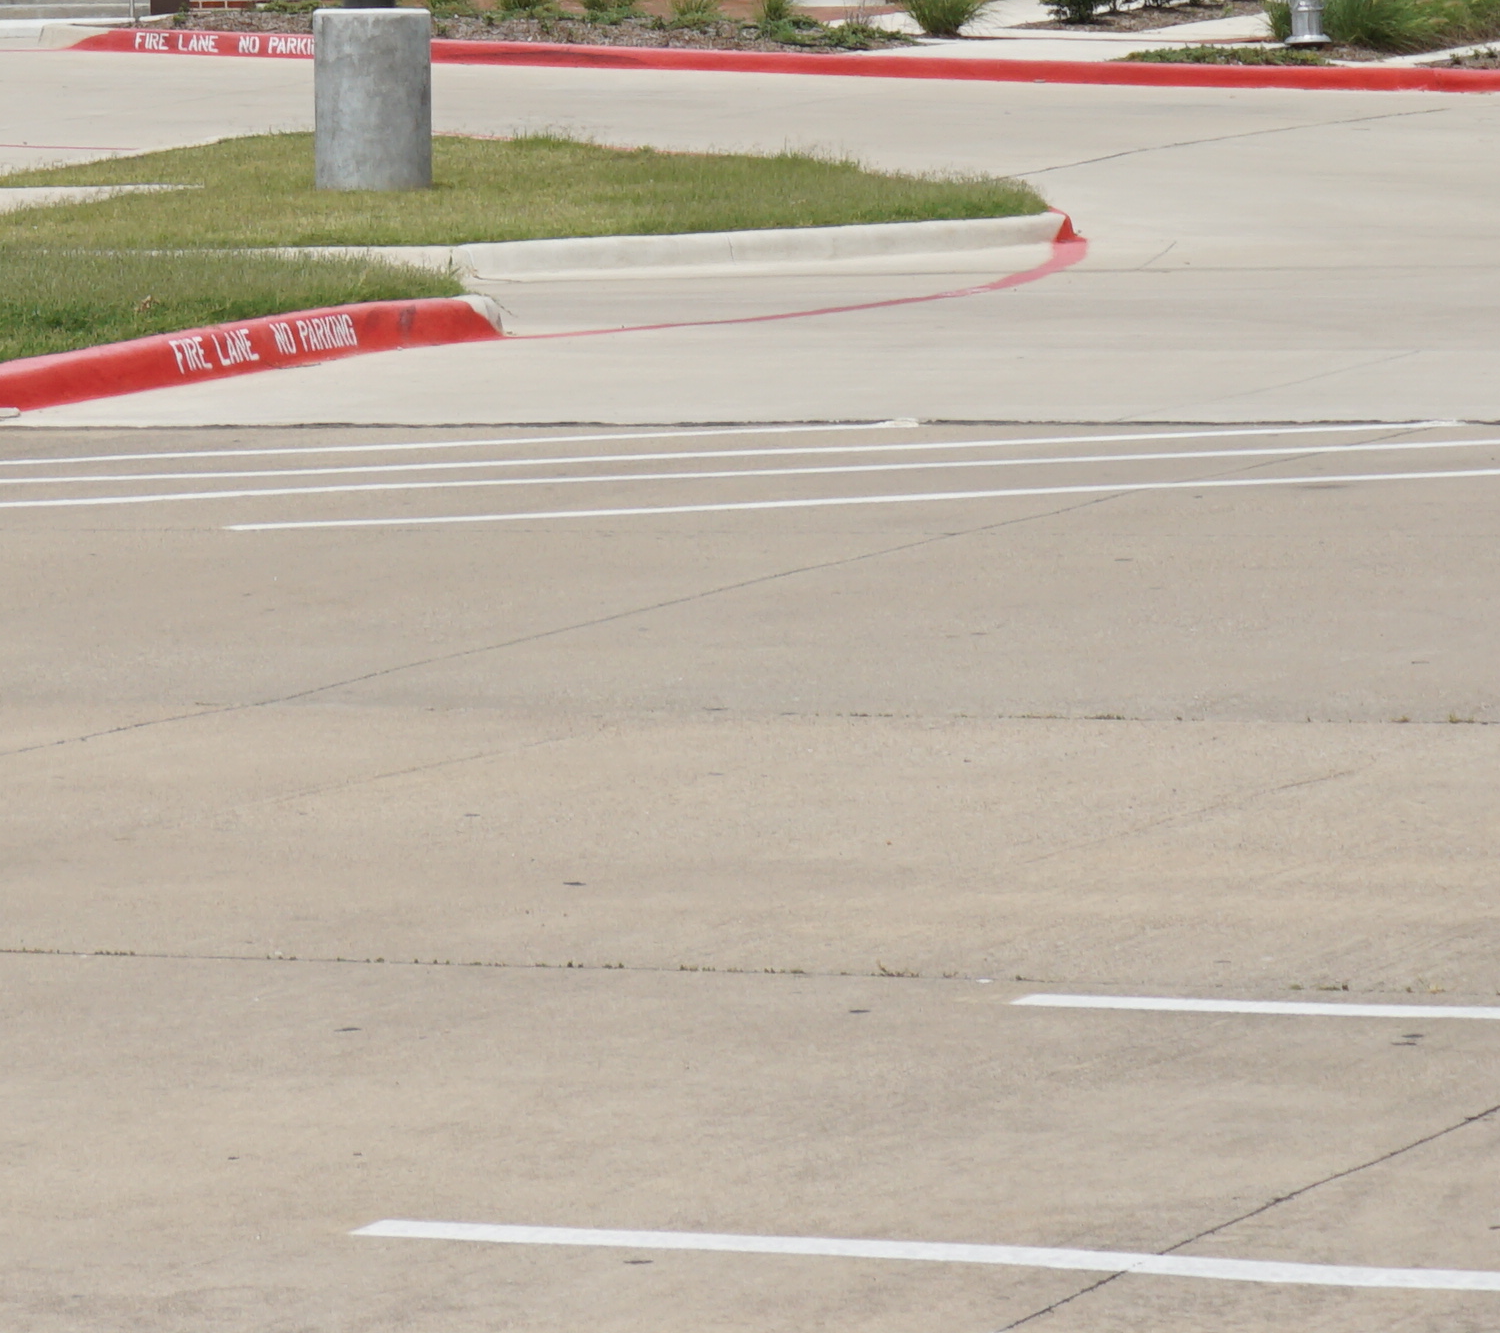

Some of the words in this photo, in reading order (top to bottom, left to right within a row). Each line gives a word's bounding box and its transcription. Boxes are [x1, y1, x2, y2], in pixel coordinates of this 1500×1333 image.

[134, 32, 170, 51] FIRE
[177, 33, 219, 53] LANE
[238, 35, 260, 54] NO
[267, 36, 315, 55] PARKI
[168, 335, 213, 375] FIRE
[211, 328, 260, 367] LANE
[269, 321, 297, 355] NO
[296, 313, 358, 353] PARKING
